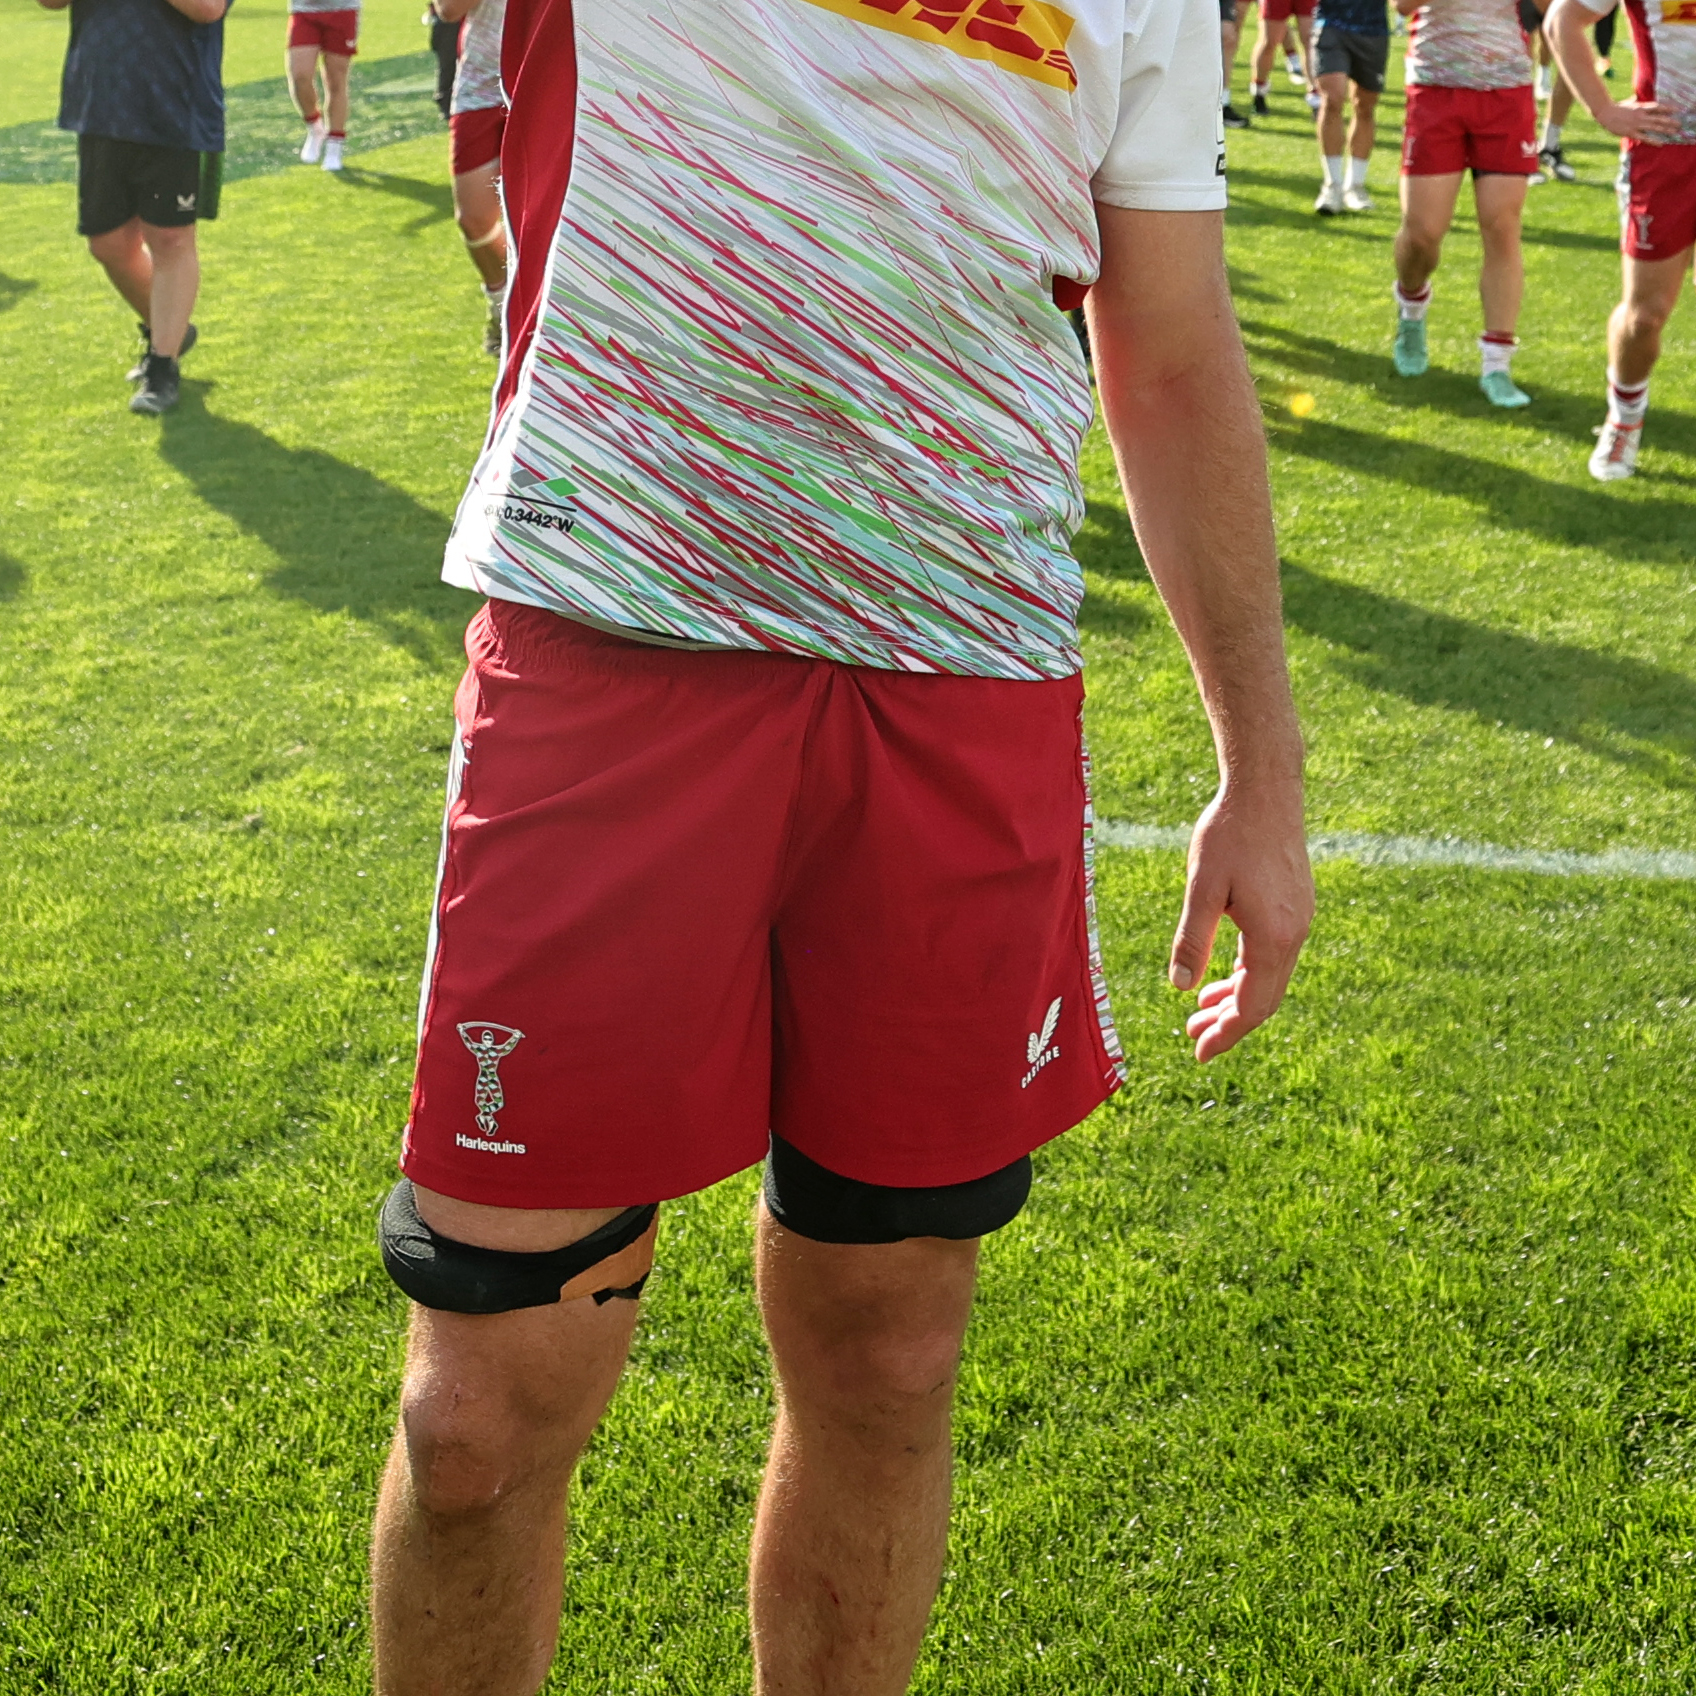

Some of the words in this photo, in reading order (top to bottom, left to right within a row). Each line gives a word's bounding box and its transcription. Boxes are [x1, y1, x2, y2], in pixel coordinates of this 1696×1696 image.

[504, 506, 575, 533] 0.3442°W
[1021, 1046, 1060, 1089] CASTORE
[456, 1132, 526, 1154] Harlequins
